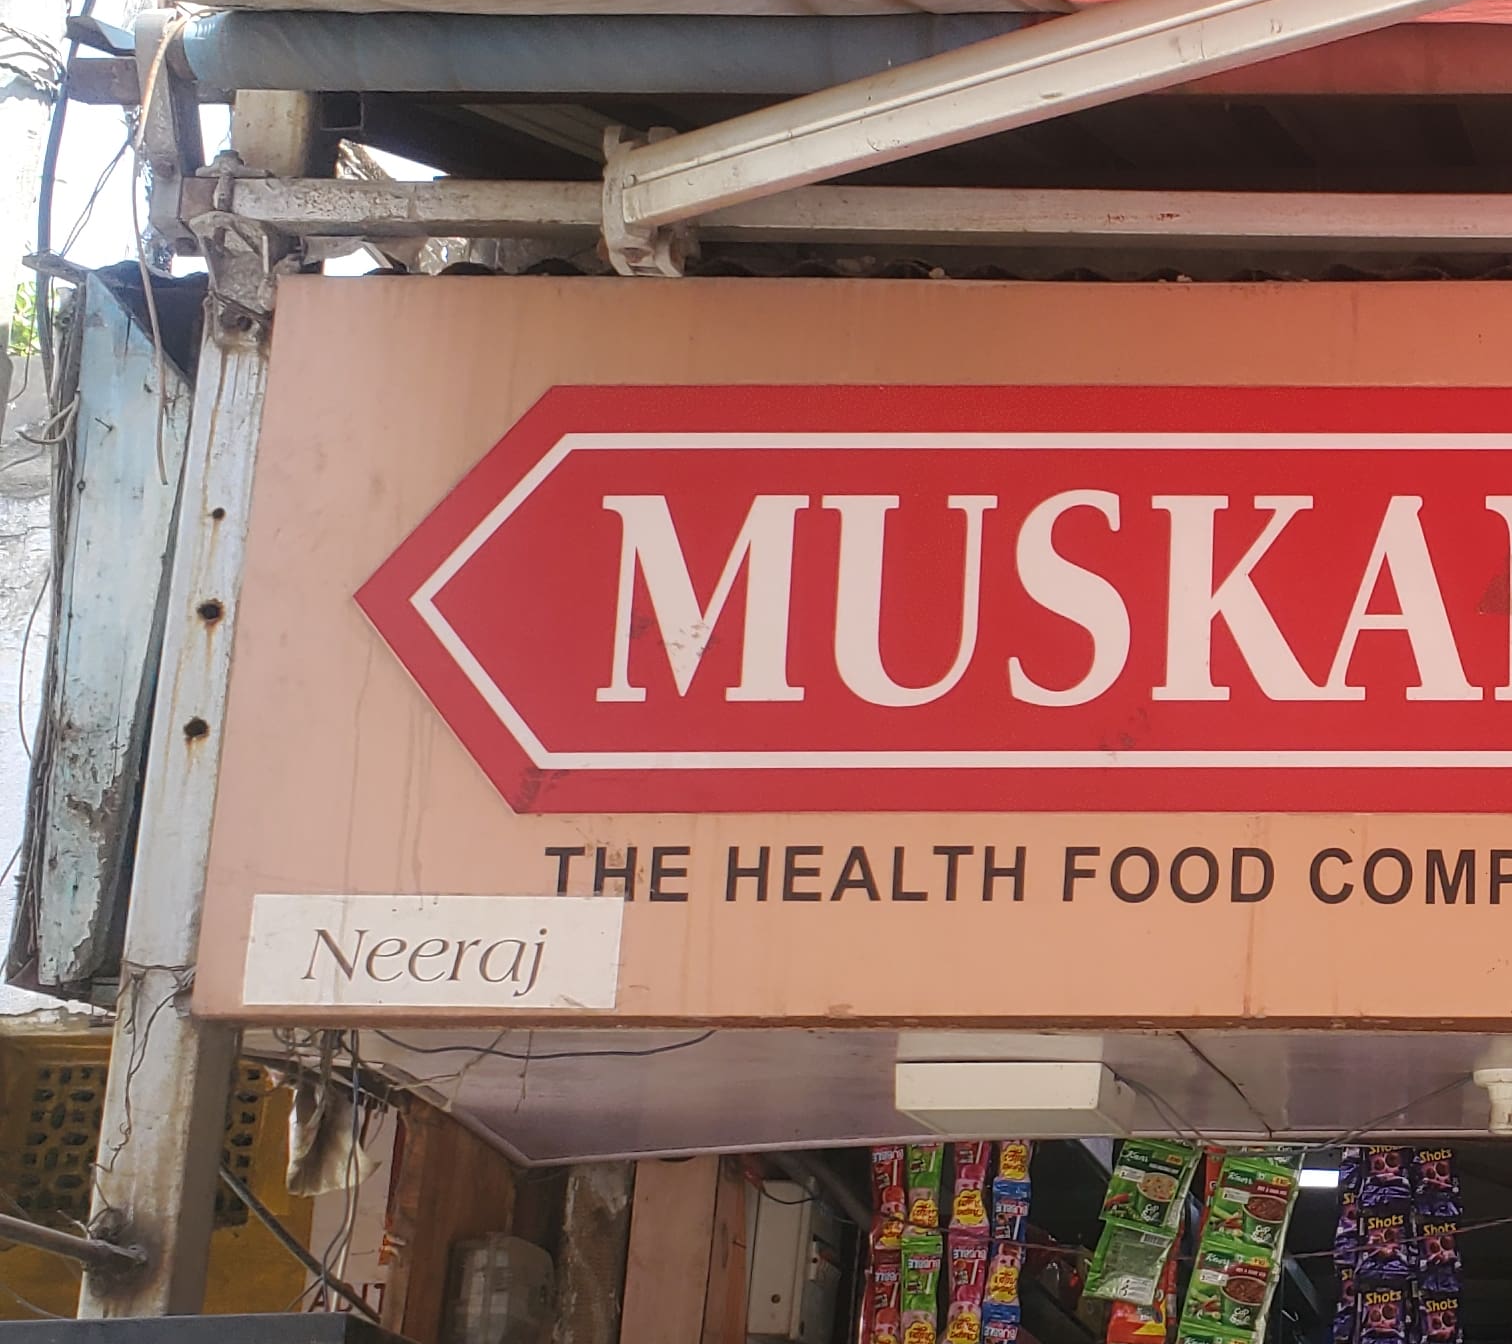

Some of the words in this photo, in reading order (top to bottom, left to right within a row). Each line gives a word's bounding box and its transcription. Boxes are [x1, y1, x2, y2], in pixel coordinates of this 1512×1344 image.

[545, 846, 690, 902] THE
[725, 846, 1027, 903] HEALTH
[1062, 846, 1275, 904] FOOD
[303, 928, 548, 998] Neeraj
[1419, 1149, 1452, 1163] Shots
[1368, 1214, 1404, 1229] Shots
[1423, 1221, 1457, 1235] Shots
[1365, 1290, 1402, 1305] Shots
[1425, 1298, 1458, 1313] Shots
